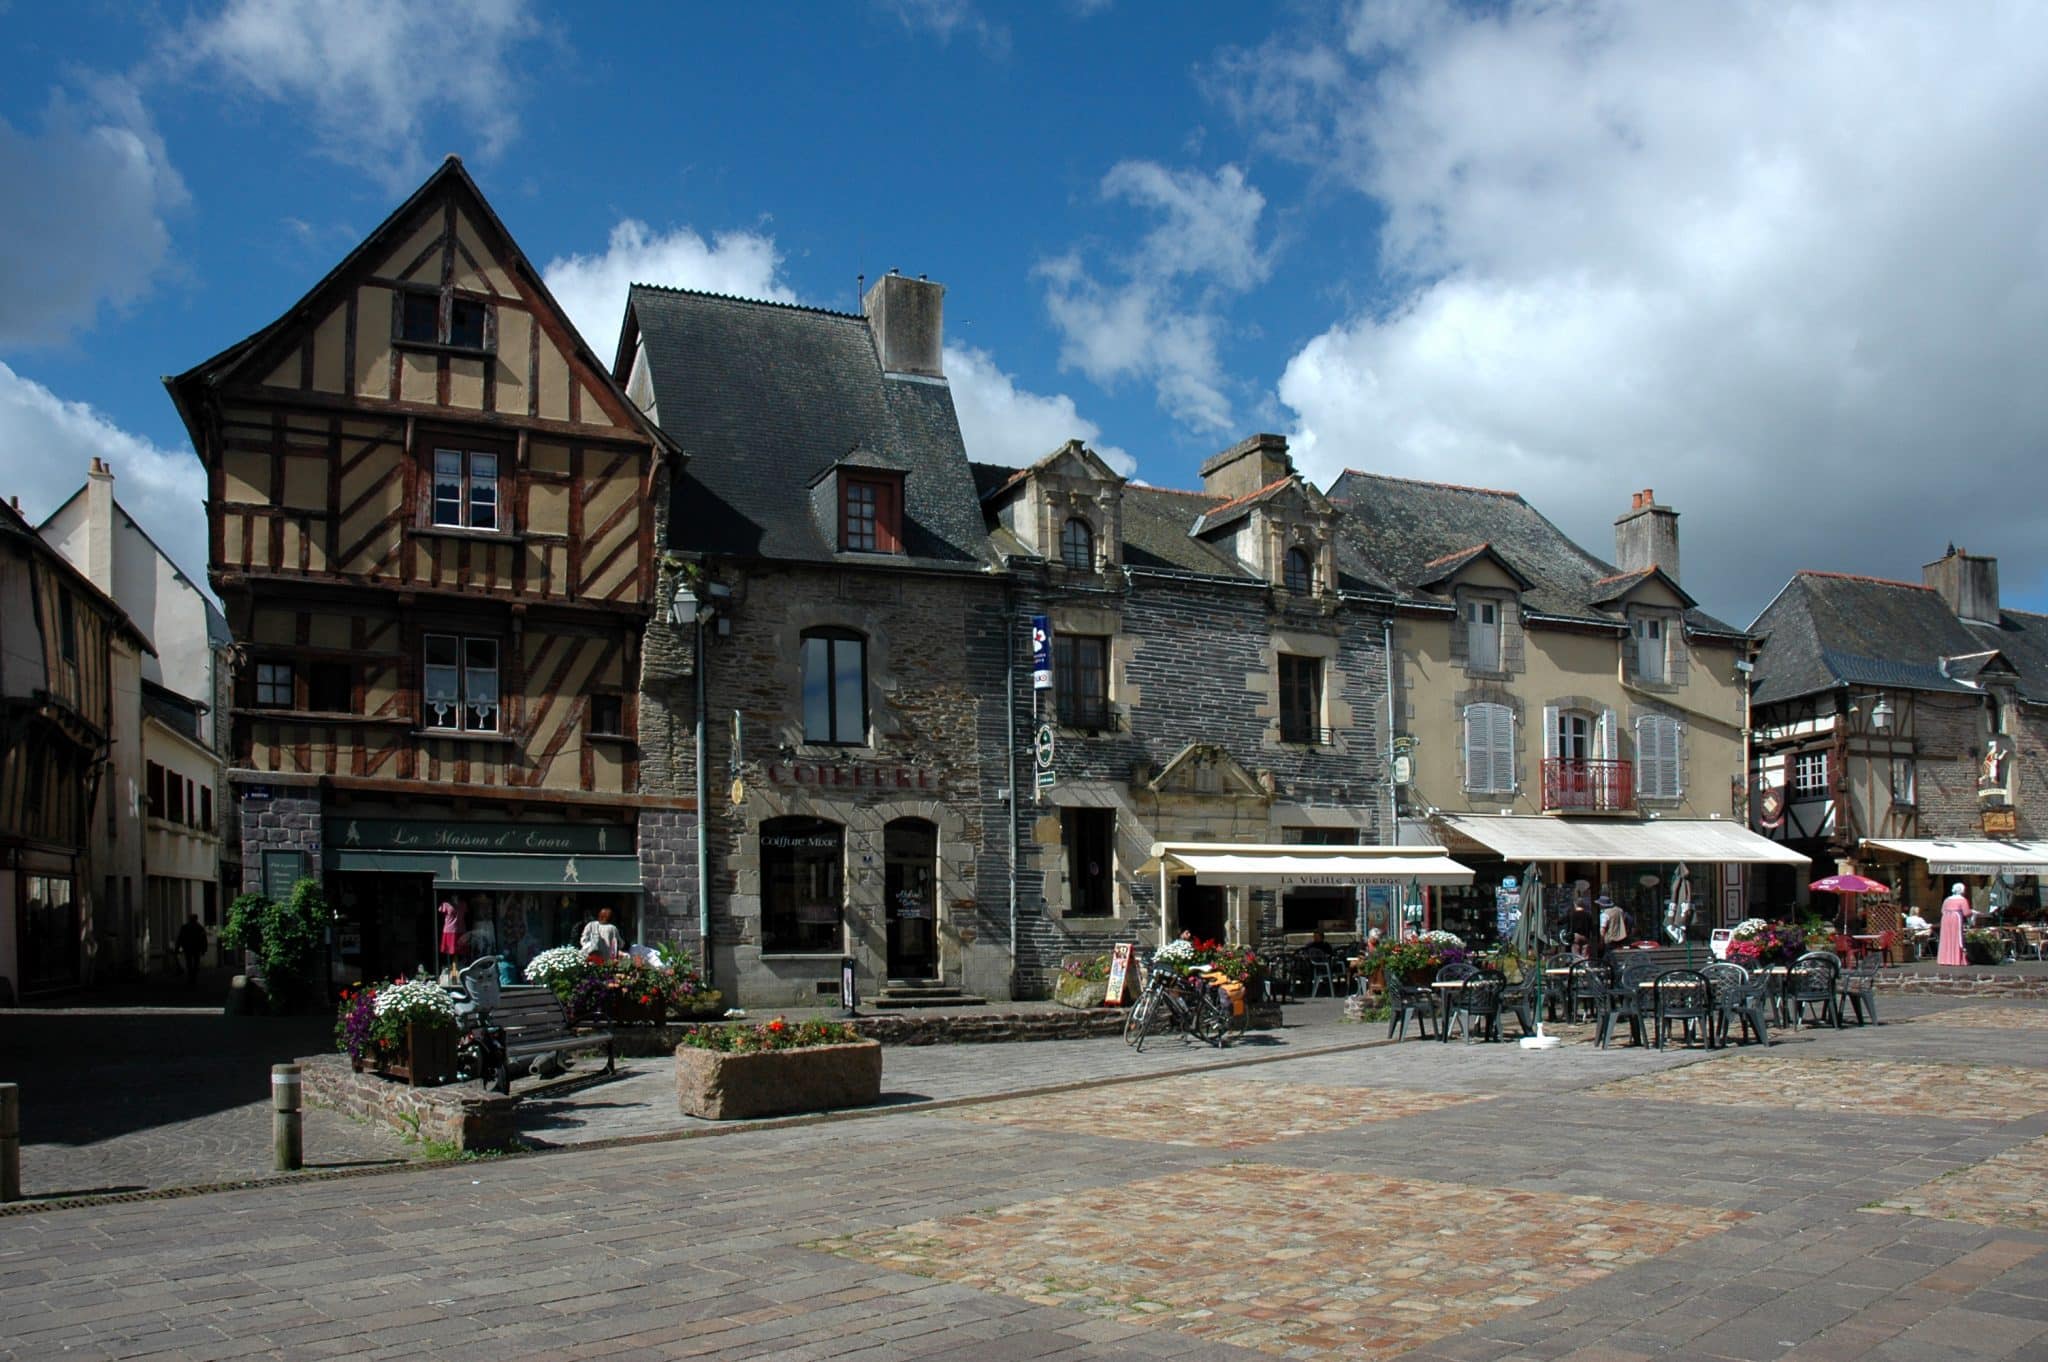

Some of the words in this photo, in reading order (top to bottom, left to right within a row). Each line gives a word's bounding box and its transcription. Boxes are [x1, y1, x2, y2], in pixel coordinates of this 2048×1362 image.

[391, 826, 419, 846] La
[434, 829, 489, 847] Maison
[525, 831, 572, 848] Enora
[760, 834, 806, 849] Coiffure
